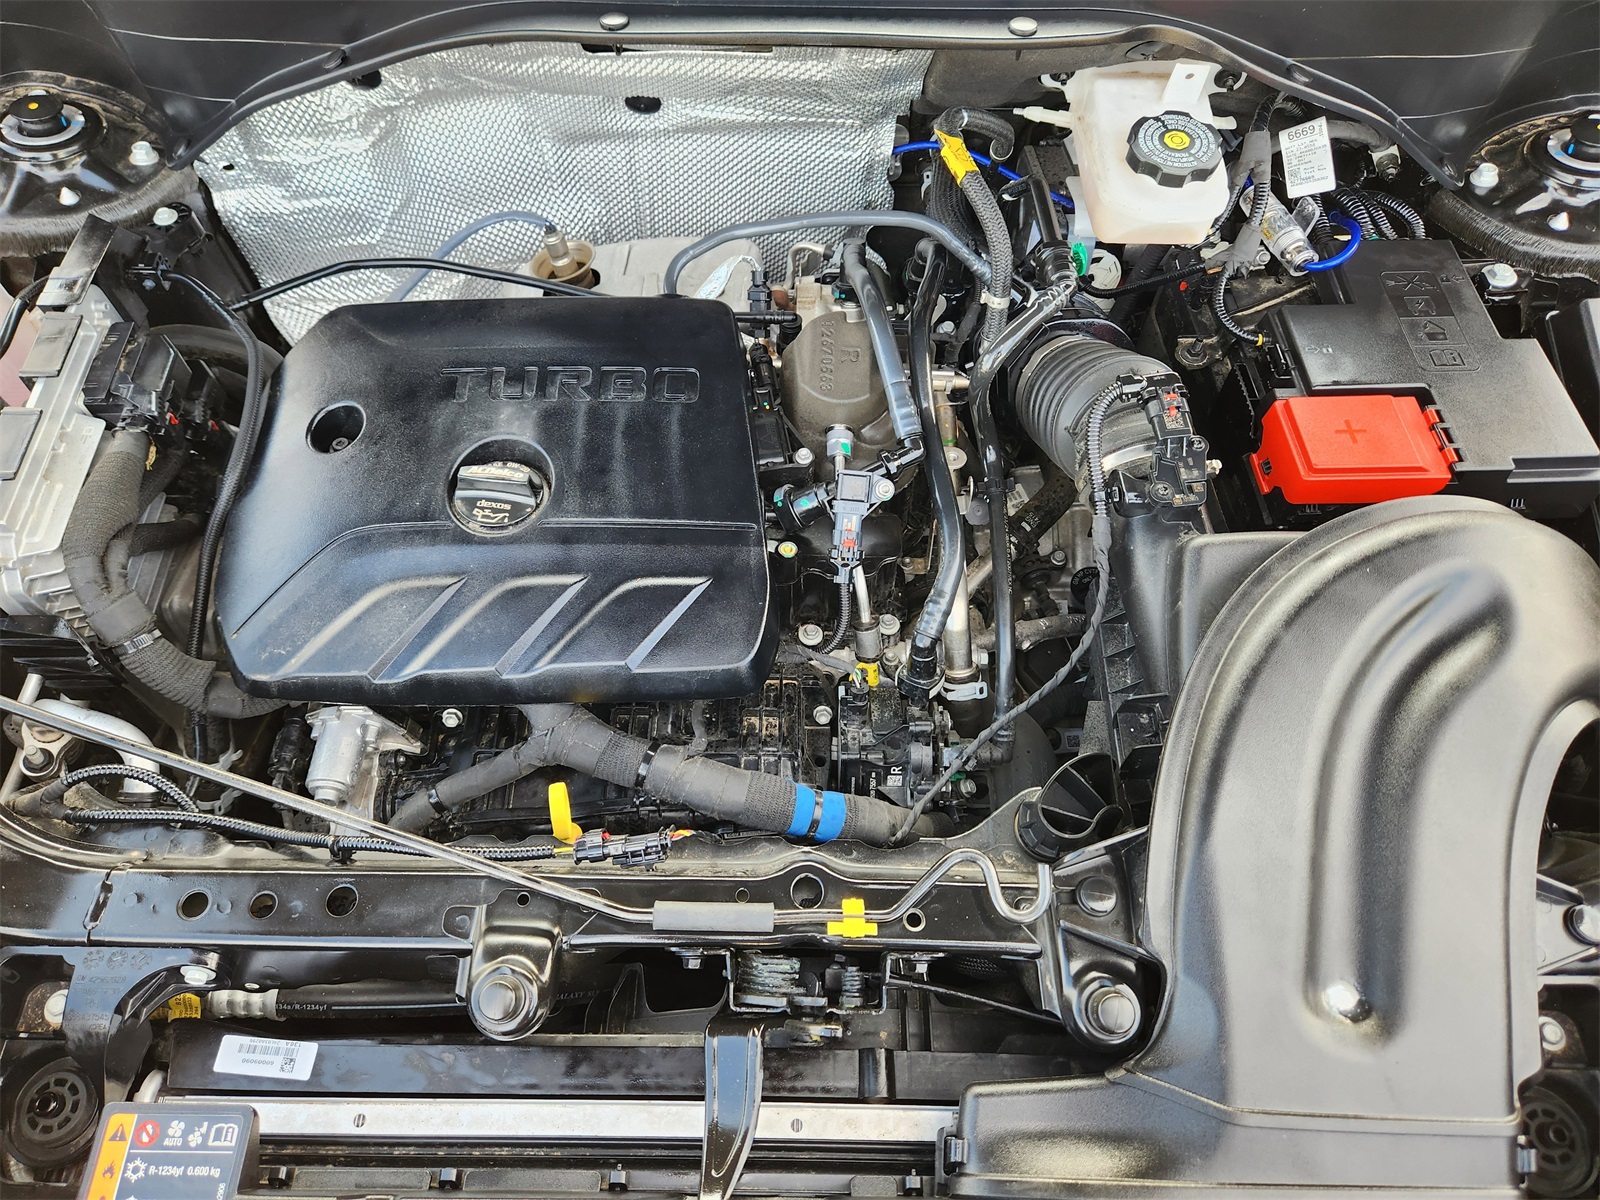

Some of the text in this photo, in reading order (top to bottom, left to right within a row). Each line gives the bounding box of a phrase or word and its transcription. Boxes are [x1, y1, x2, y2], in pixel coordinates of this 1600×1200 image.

[1288, 125, 1315, 140] 6669
[841, 346, 861, 363] R
[441, 366, 700, 403] TURBO
[467, 466, 523, 478] ACDelco
[507, 462, 530, 472] 0W-20
[477, 500, 512, 510] dexos
[163, 1138, 183, 1146] AUTO
[149, 1166, 220, 1178] R-1234yf 0.600 kg
